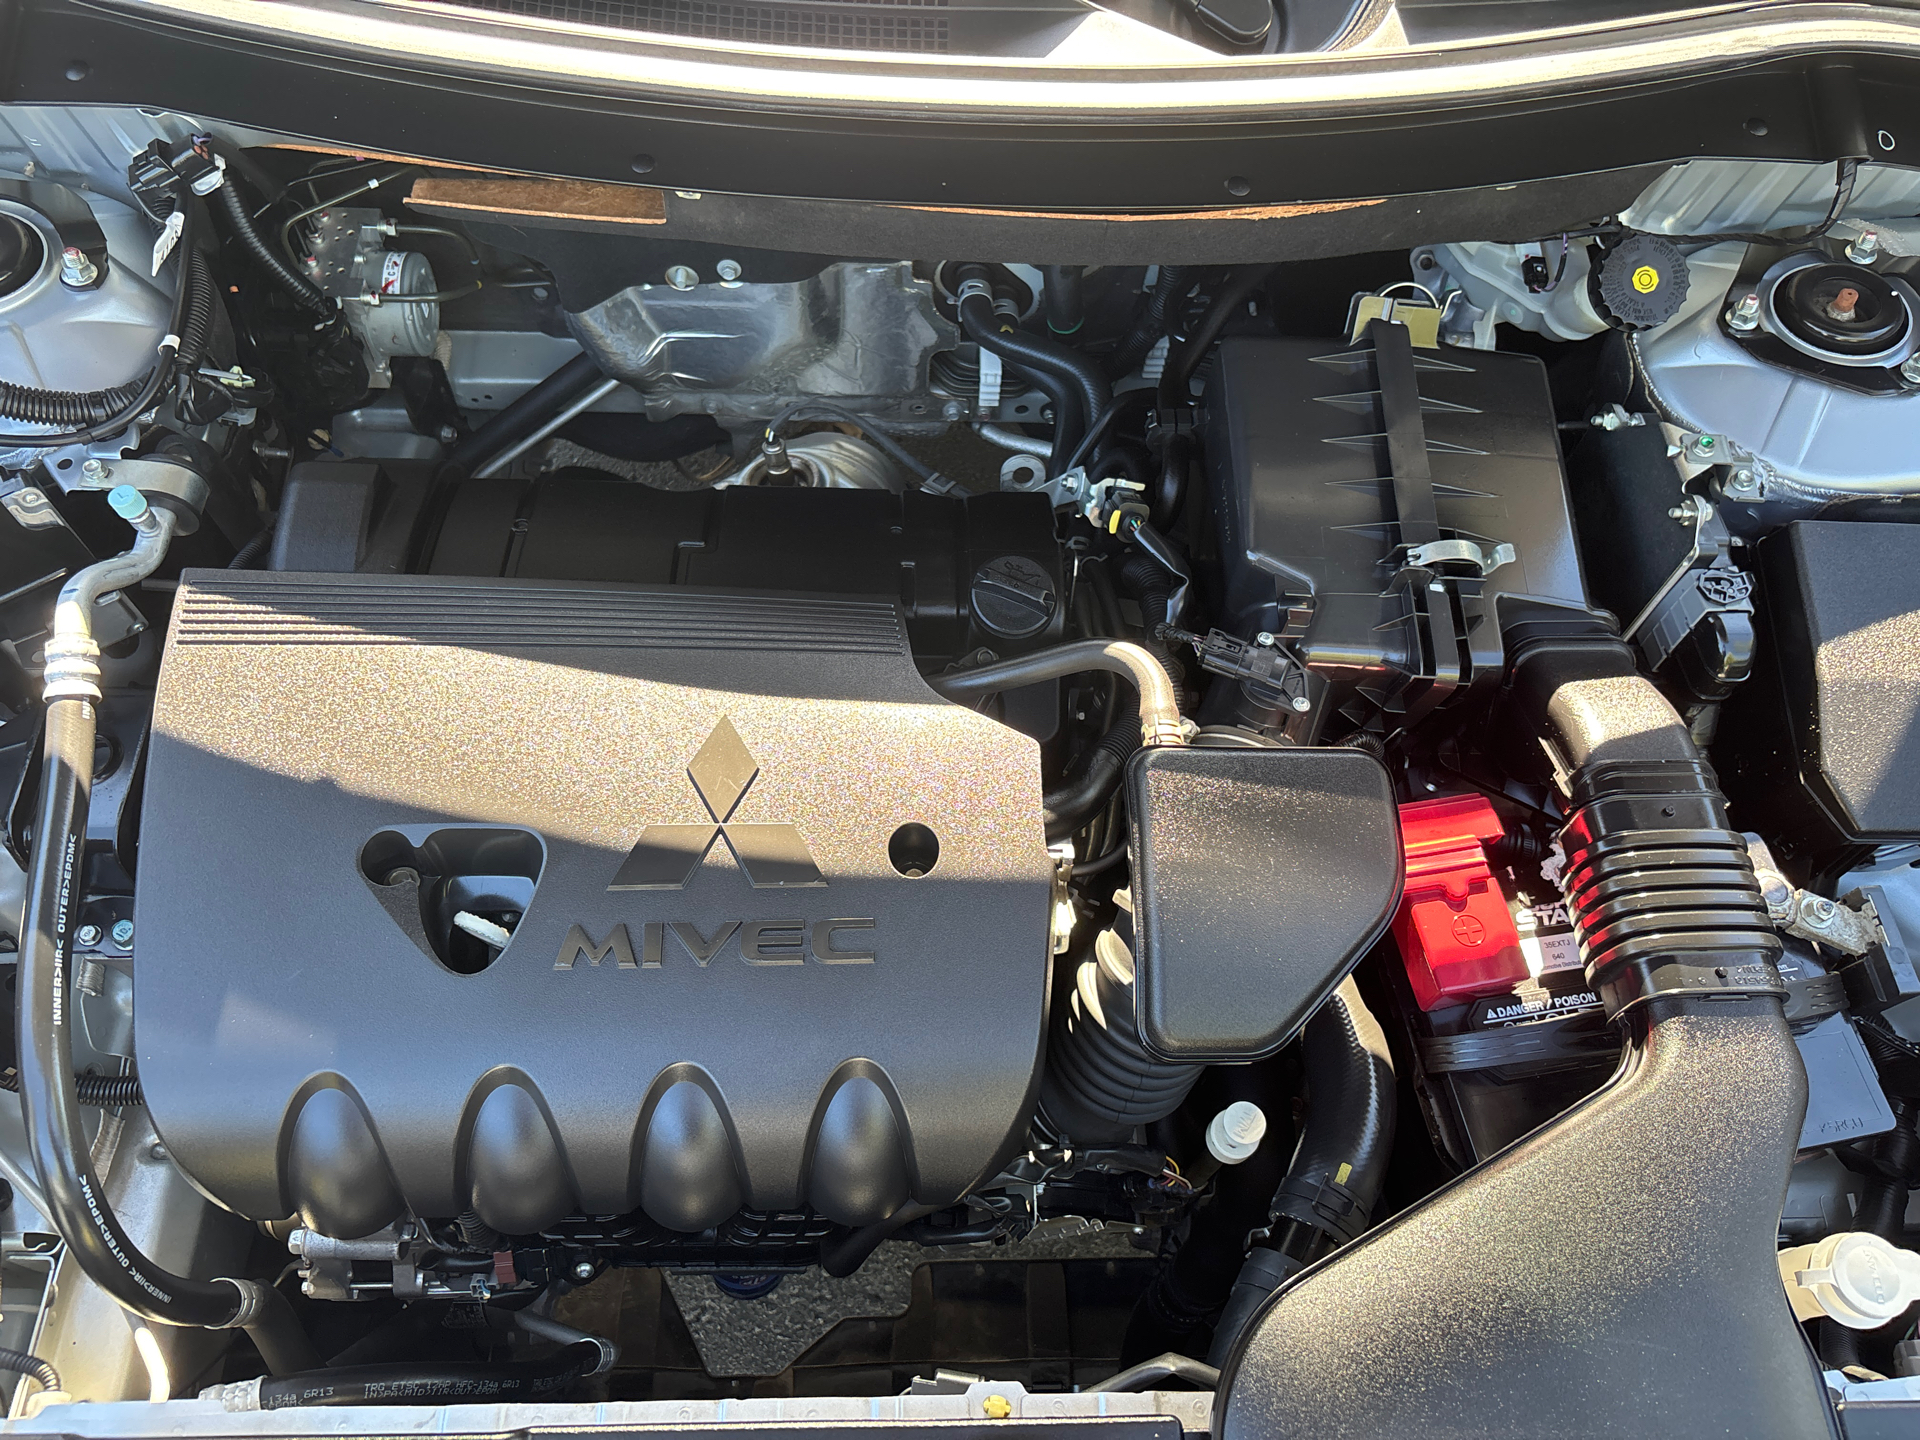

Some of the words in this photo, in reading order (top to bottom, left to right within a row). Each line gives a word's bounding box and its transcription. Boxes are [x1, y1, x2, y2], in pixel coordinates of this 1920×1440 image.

[1516, 908, 1570, 931] STA
[552, 917, 876, 971] MIVEC
[1544, 939, 1571, 949] 35EXTJ
[1551, 952, 1565, 960] 640
[1496, 1000, 1545, 1018] DANGER
[1553, 992, 1597, 1008] POISON
[303, 1386, 335, 1399] 6R13
